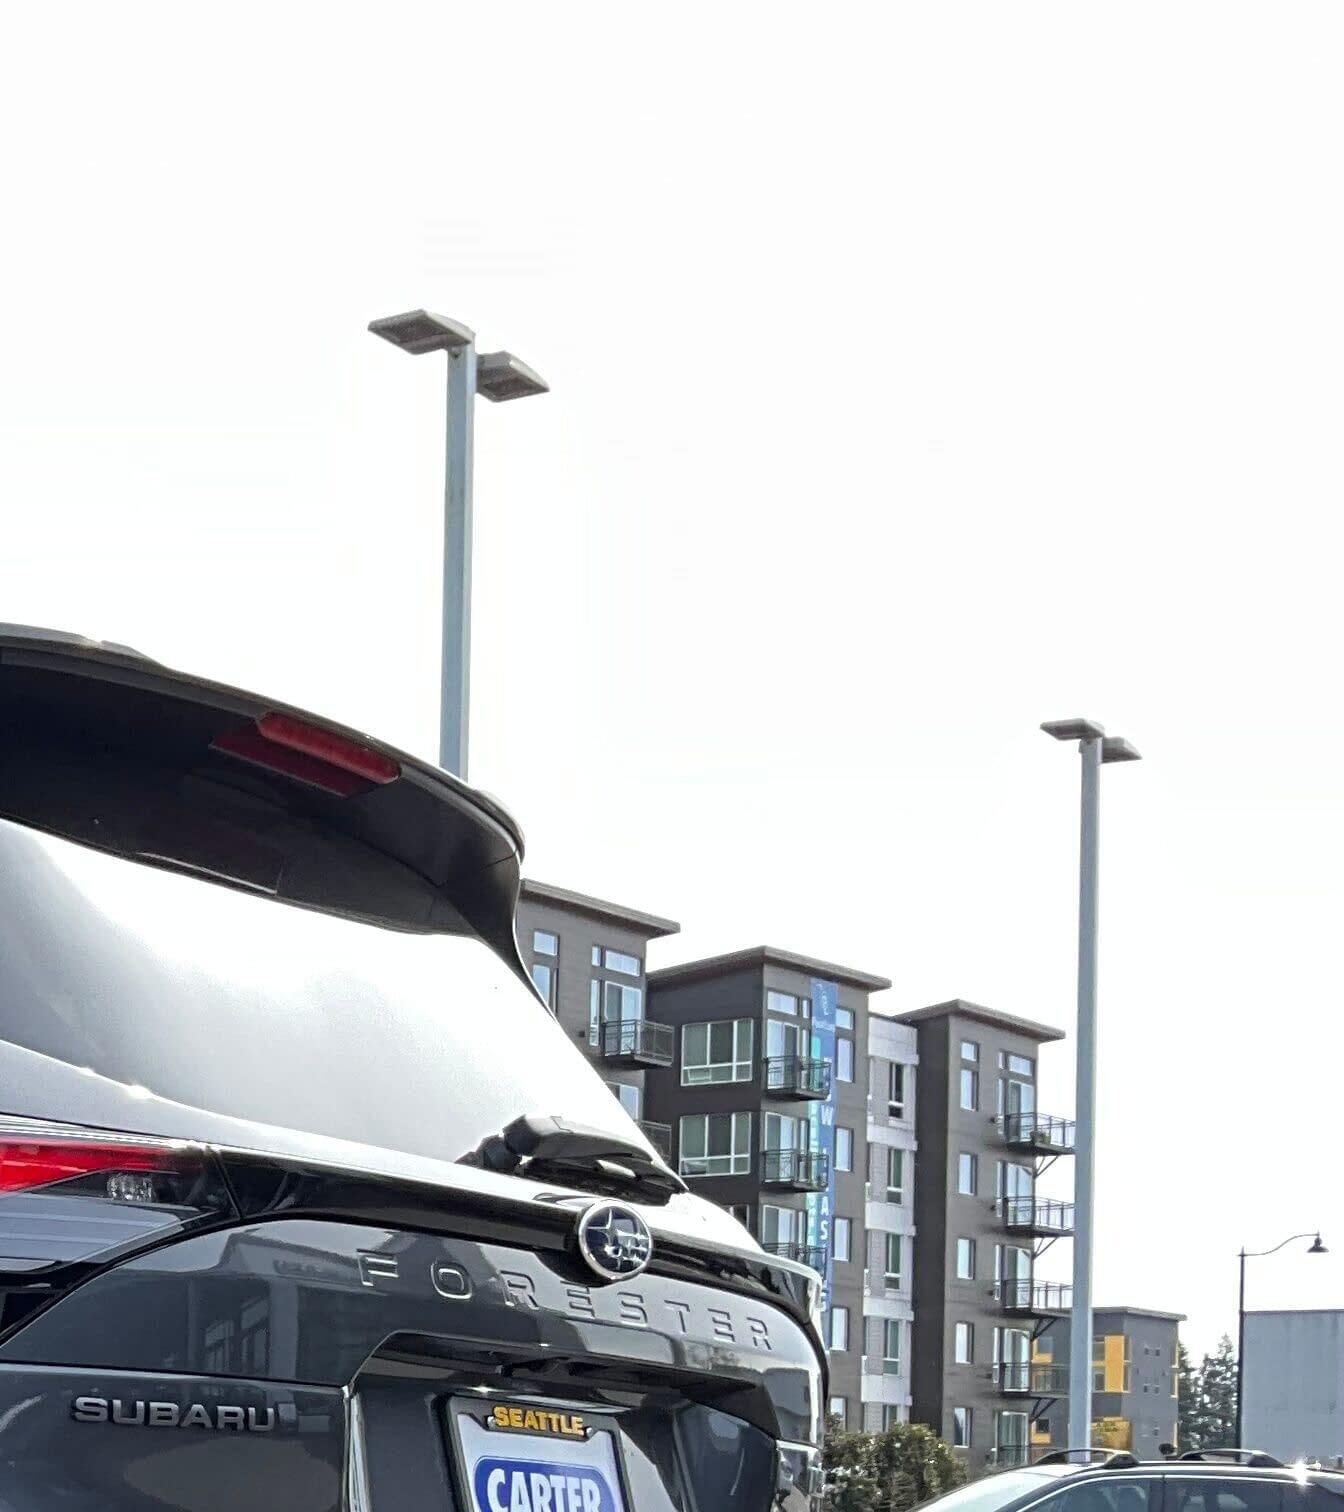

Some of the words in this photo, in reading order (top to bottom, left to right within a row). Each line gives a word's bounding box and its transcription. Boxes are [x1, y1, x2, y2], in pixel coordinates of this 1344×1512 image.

[356, 1247, 773, 1351] FORESTER
[73, 1396, 275, 1432] SUBARU
[493, 1406, 586, 1436] SEATTLE
